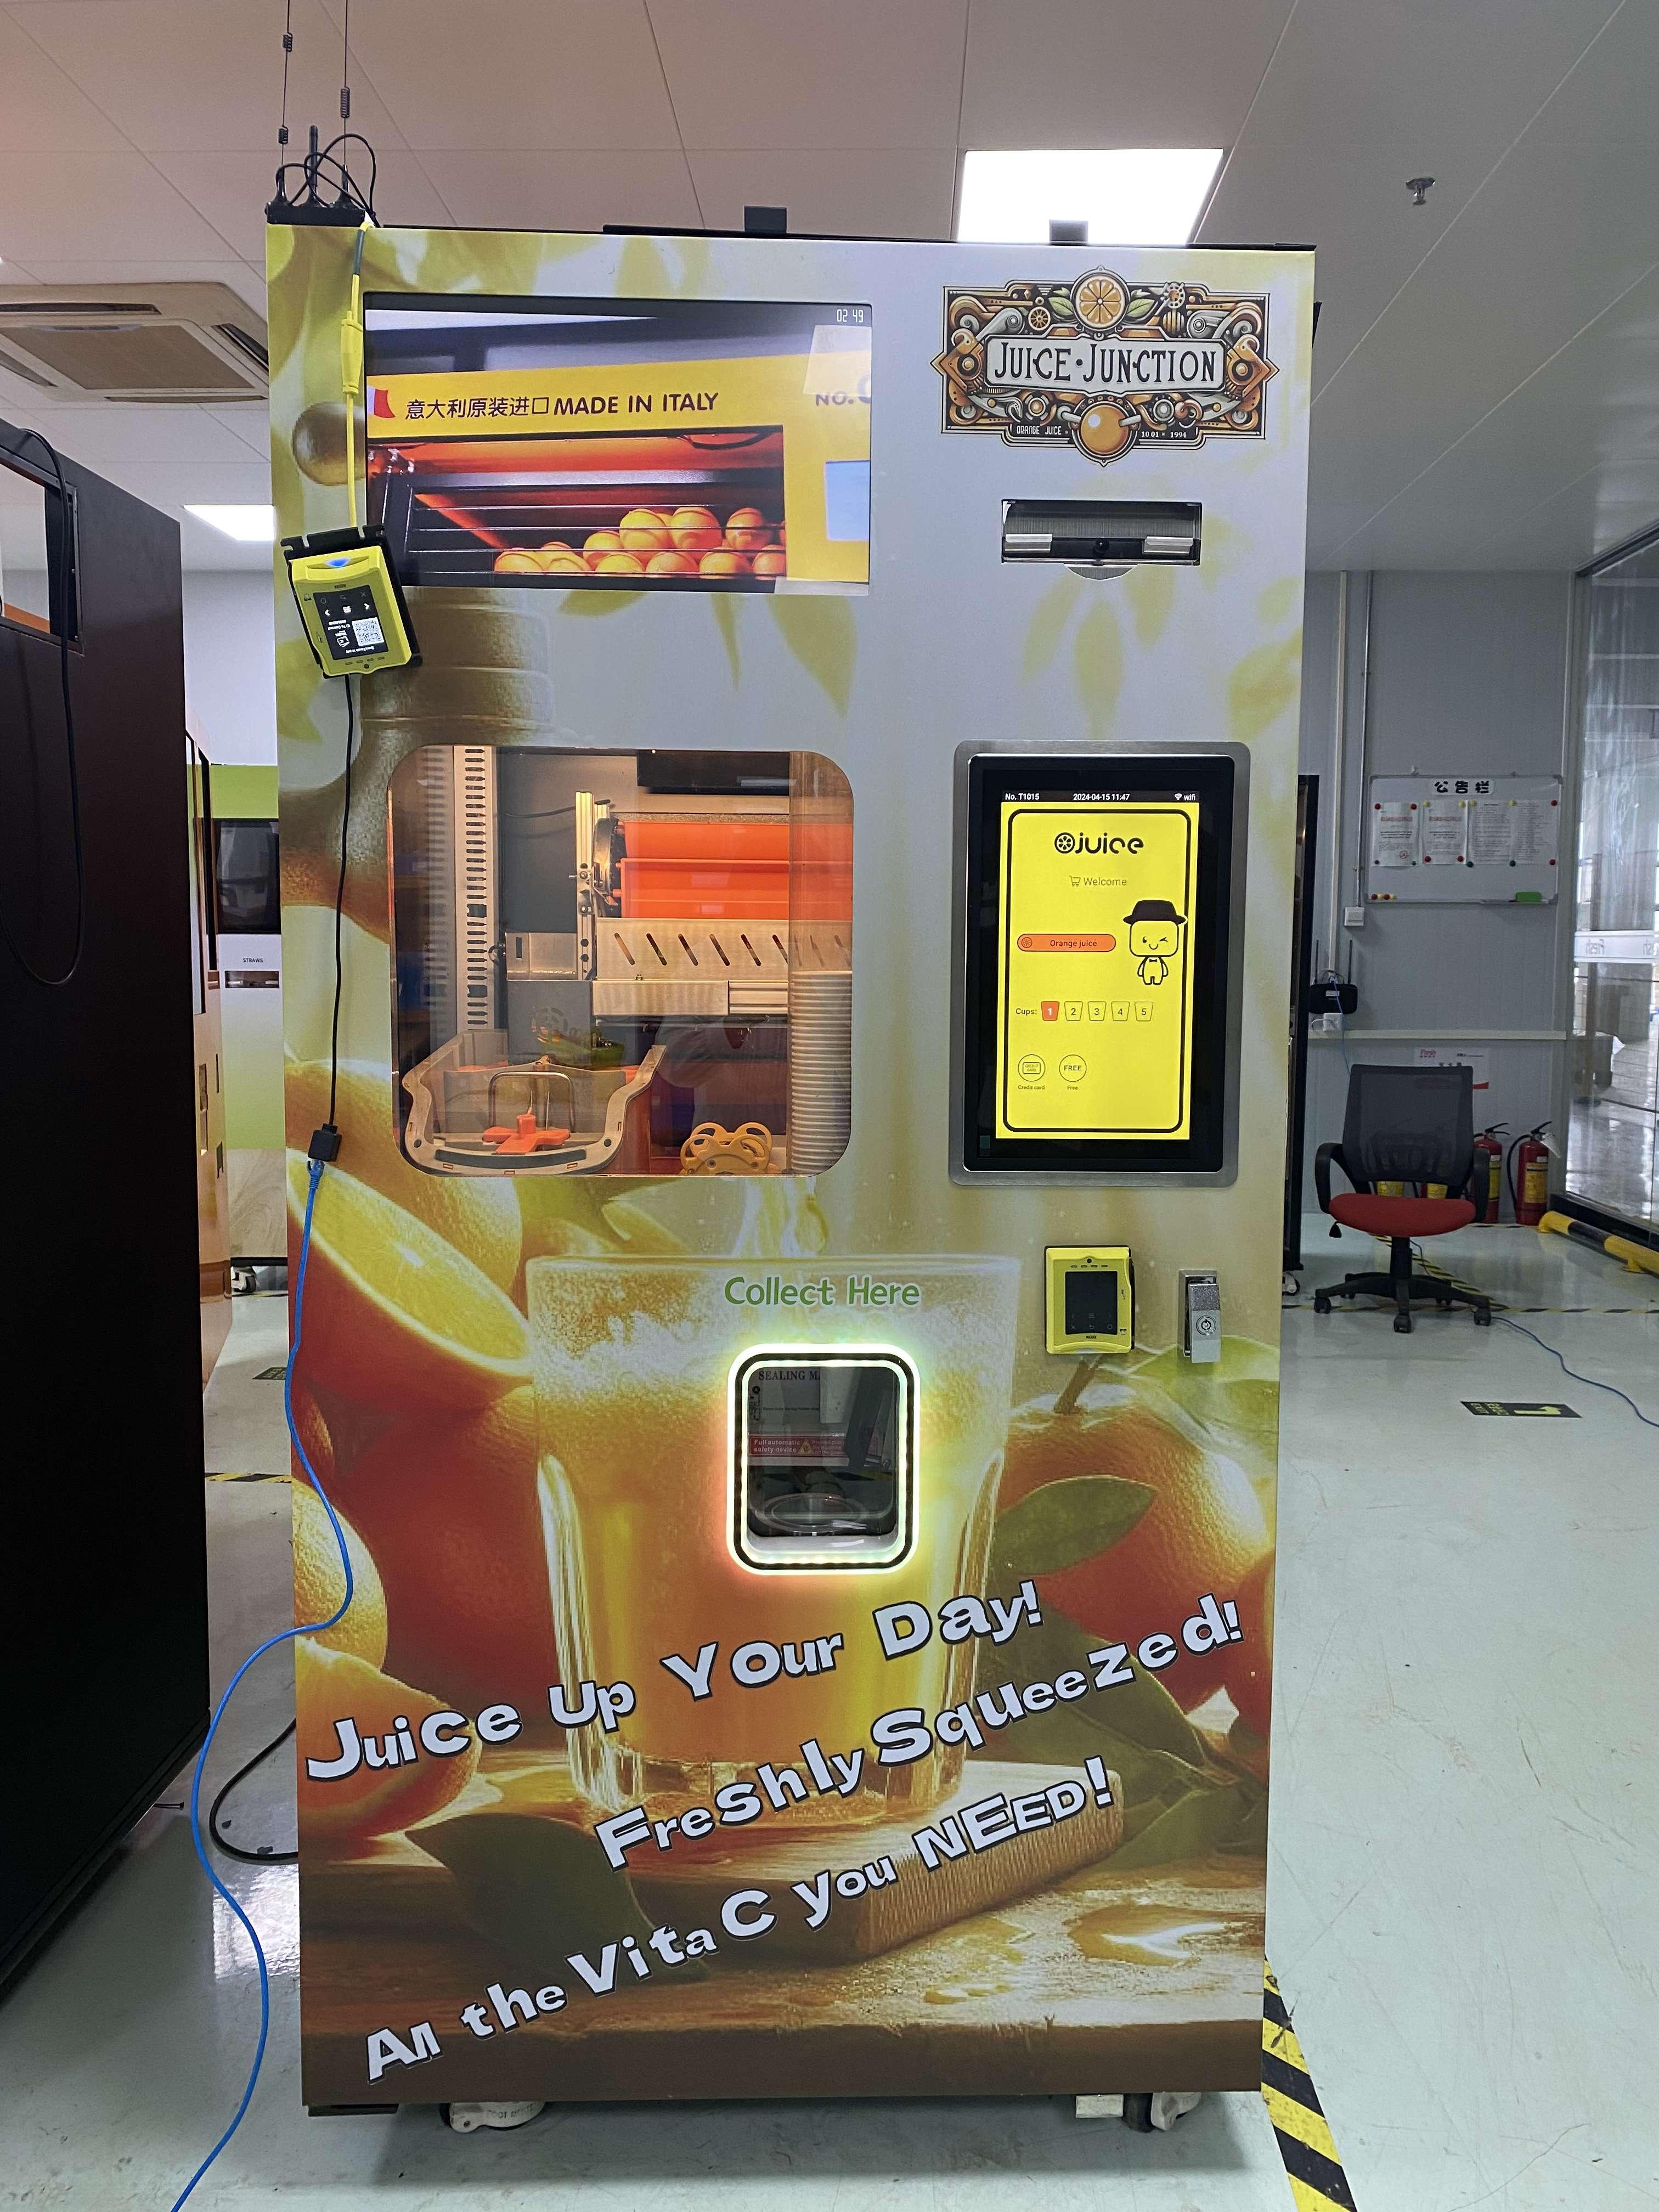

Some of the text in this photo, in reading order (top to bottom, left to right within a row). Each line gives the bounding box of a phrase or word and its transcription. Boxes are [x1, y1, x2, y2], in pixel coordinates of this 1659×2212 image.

[837, 309, 864, 323] 02 49
[995, 341, 1216, 384] JUICE JUNCTION
[405, 392, 719, 420] 意大利原装进口 MADE IN ITALY
[1017, 426, 1062, 435] ORANGE JUICE
[1084, 877, 1127, 886] Welcome
[1050, 940, 1077, 948] Orange
[724, 1276, 920, 1306] Collect Here
[758, 1371, 821, 1380] SEALING M
[548, 1680, 636, 1731] Up
[874, 1581, 1043, 1660] Day!
[595, 1738, 865, 1872] Freshly
[461, 1982, 568, 2039] the
[566, 1923, 719, 1997] Vita
[792, 1855, 898, 1931] you
[913, 1755, 1115, 1873] NEED!
